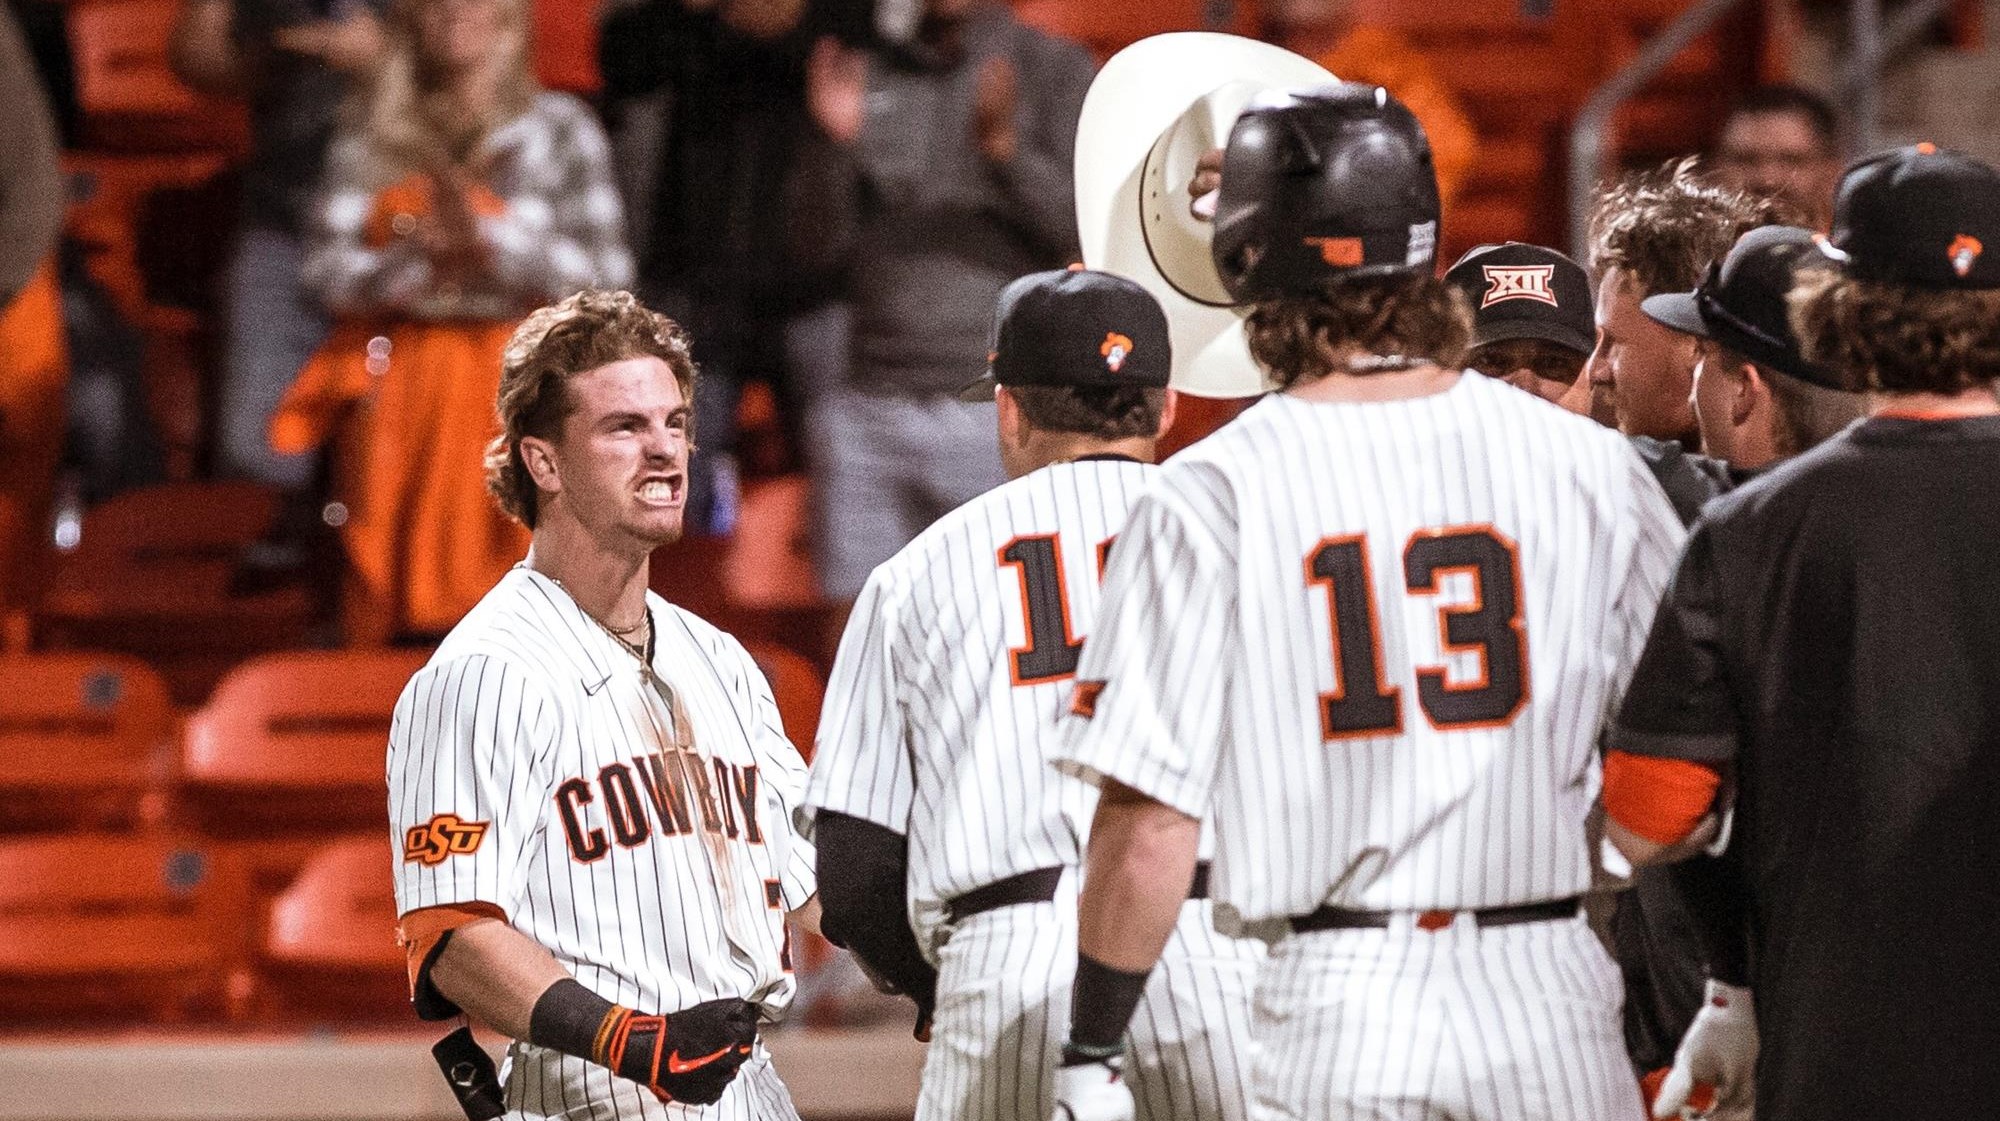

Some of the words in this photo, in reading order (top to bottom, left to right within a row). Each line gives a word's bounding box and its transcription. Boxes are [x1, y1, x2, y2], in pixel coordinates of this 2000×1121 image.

[1482, 265, 1556, 307] XII
[998, 533, 1119, 685] 1
[1304, 522, 1531, 743] 13
[404, 813, 490, 867] OSU
